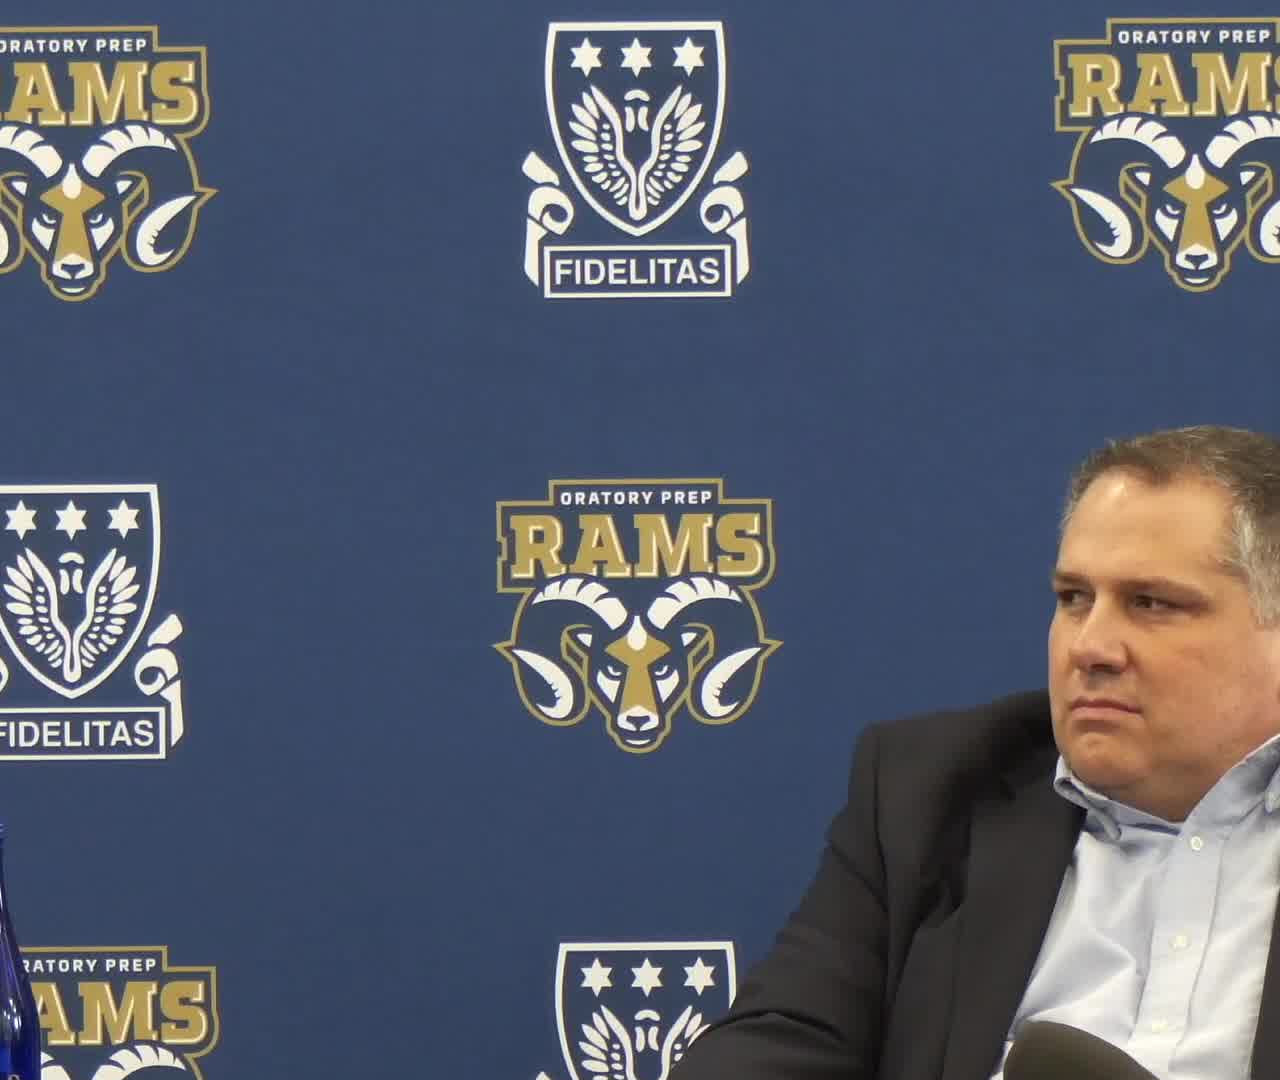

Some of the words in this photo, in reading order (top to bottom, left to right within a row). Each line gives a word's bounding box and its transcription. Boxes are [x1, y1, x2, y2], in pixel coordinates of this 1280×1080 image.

[1118, 30, 1210, 44] ORATORY
[1219, 30, 1270, 43] PREP
[96, 38, 146, 52] PREP
[555, 258, 719, 285] FIDELITAS
[561, 492, 652, 505] ORATORY
[661, 491, 711, 504] PREP
[512, 513, 763, 577] RAMS
[23, 959, 96, 972] RATORY
[106, 959, 155, 972] PREP
[31, 981, 207, 1044] AMS
